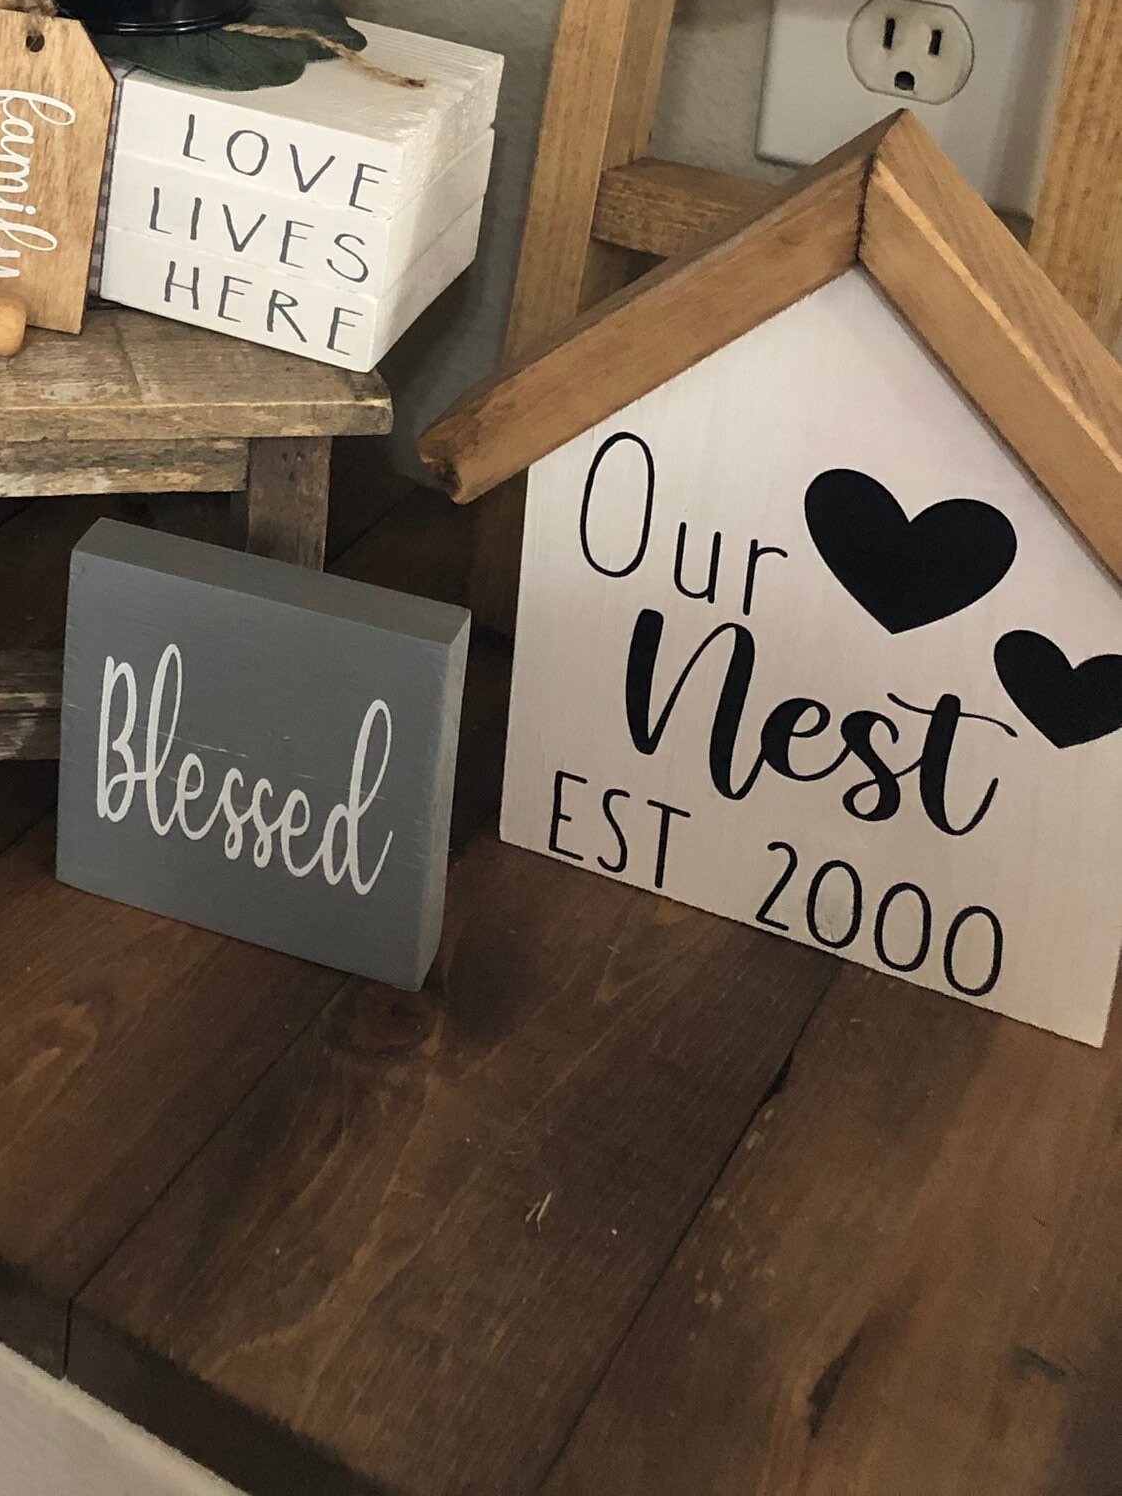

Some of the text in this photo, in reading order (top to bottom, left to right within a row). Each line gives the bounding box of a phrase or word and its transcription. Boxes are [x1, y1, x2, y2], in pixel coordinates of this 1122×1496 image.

[149, 187, 370, 283] LIVES
[181, 113, 388, 214] LOVE
[164, 260, 364, 357] HERE
[580, 432, 788, 616] Our
[96, 643, 393, 896] Blessed
[625, 608, 1018, 836] Nest
[549, 770, 1004, 997] EST 2000
